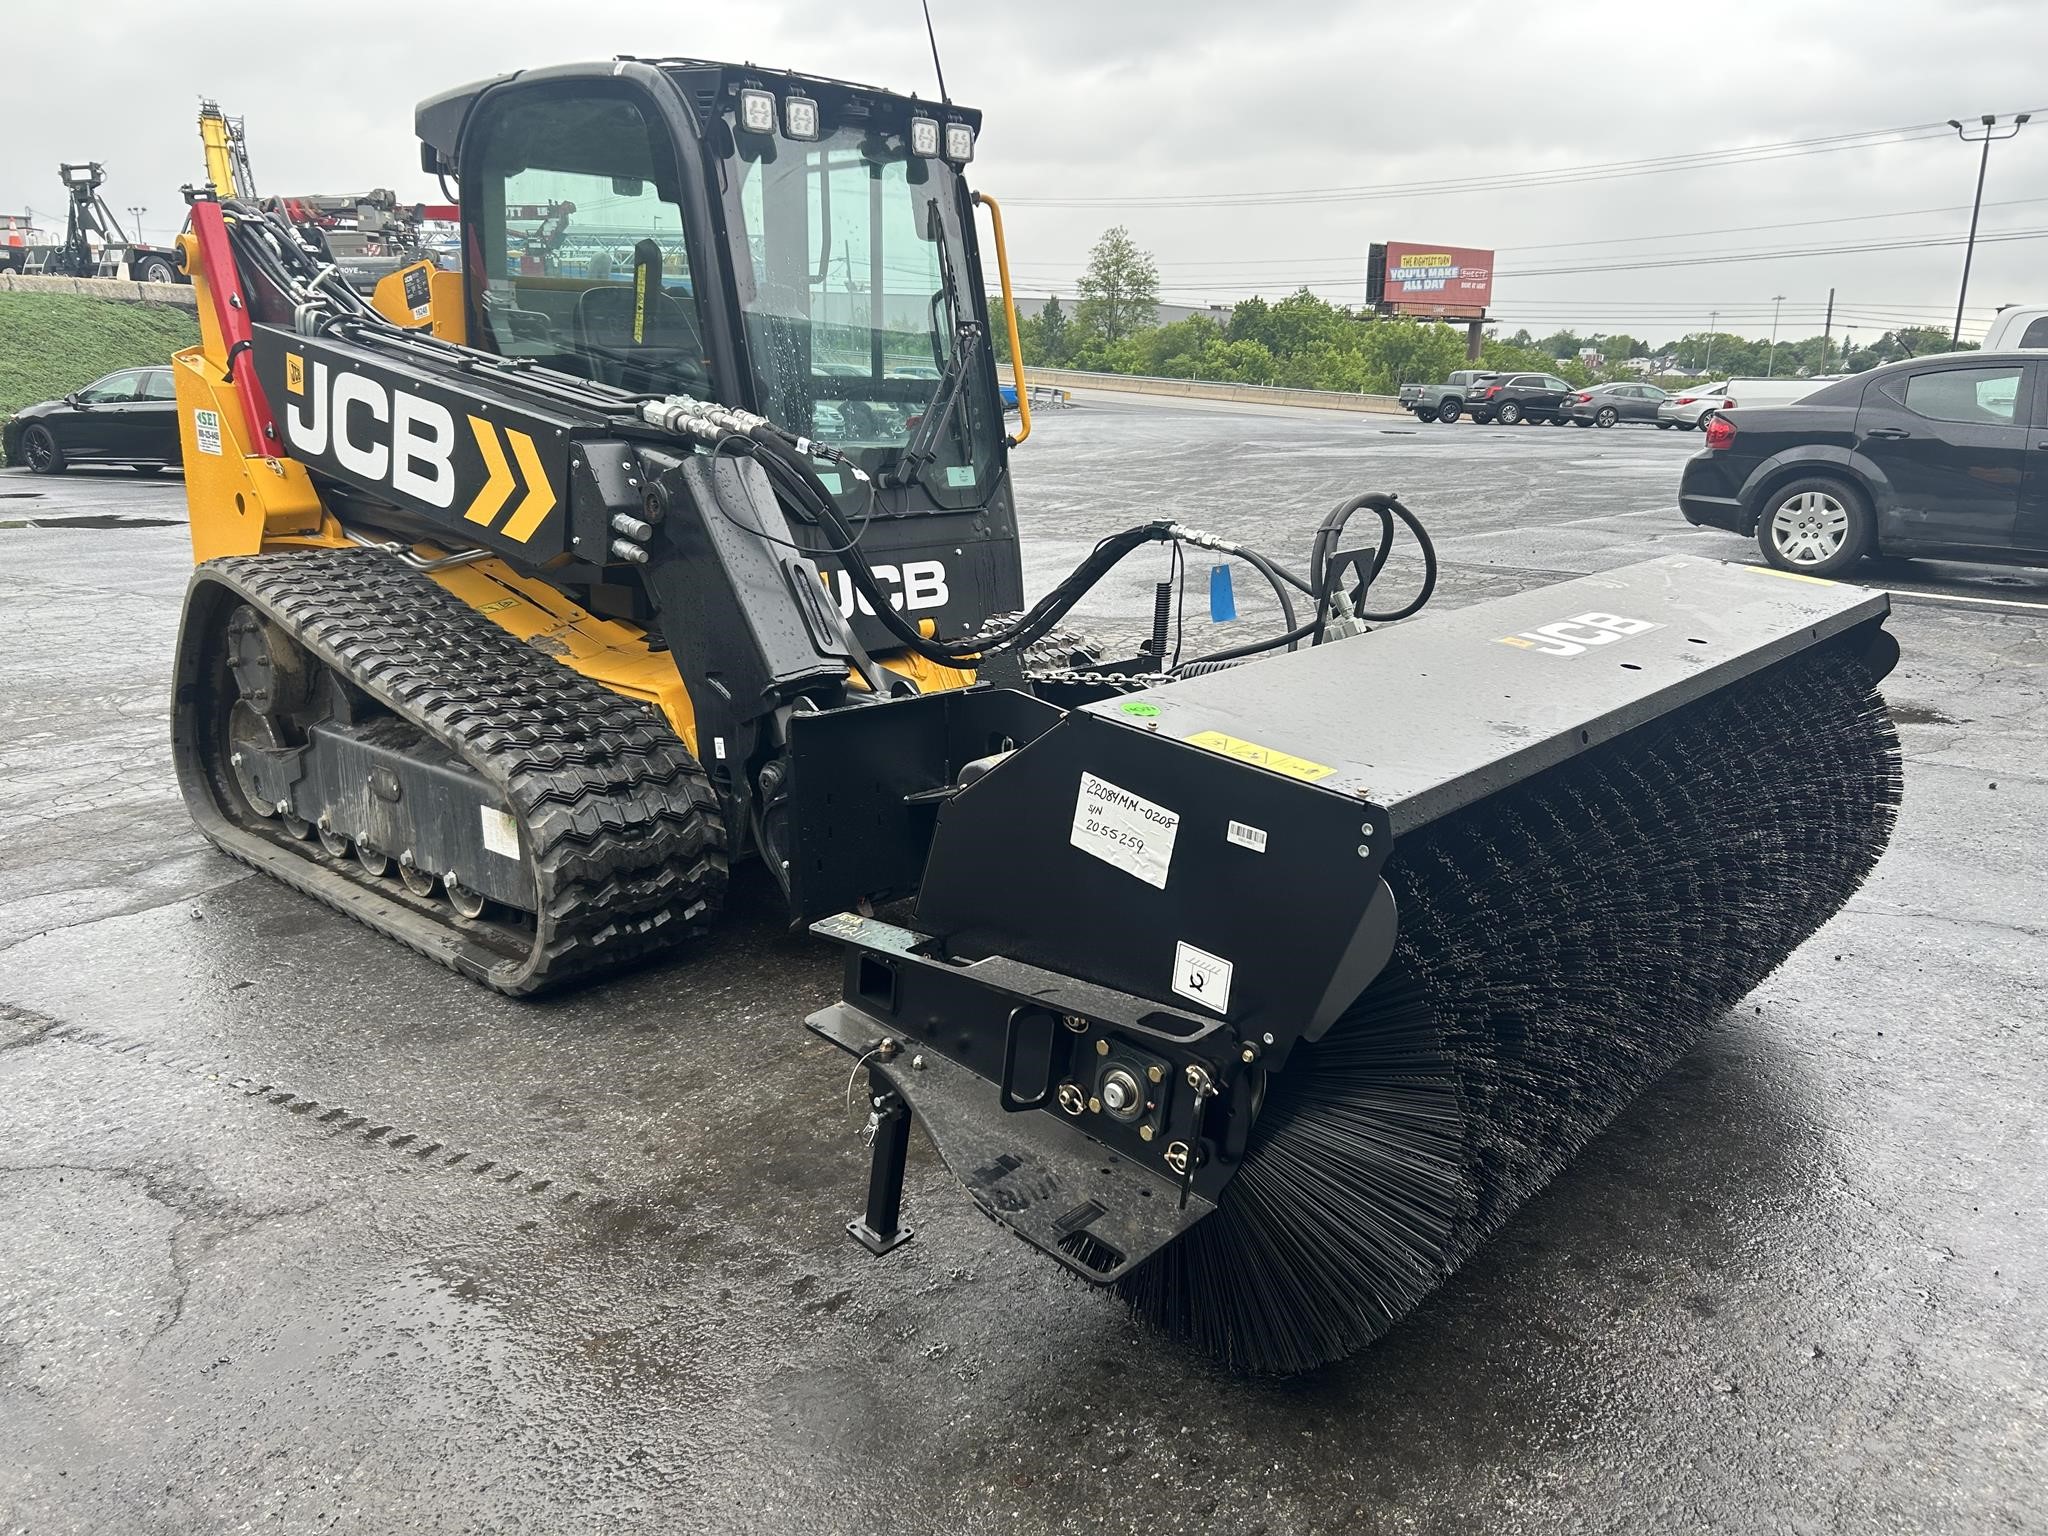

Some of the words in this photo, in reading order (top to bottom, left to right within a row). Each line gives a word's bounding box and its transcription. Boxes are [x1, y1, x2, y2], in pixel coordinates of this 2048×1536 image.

[1403, 256, 1413, 267] THE
[1391, 267, 1426, 280] YOU'LL
[1428, 267, 1459, 279] MAKE
[1403, 280, 1422, 291] ALL
[1423, 279, 1446, 290] DAY
[287, 361, 455, 508] JCB
[1518, 612, 1656, 656] JCB
[1088, 804, 1103, 816] S/N
